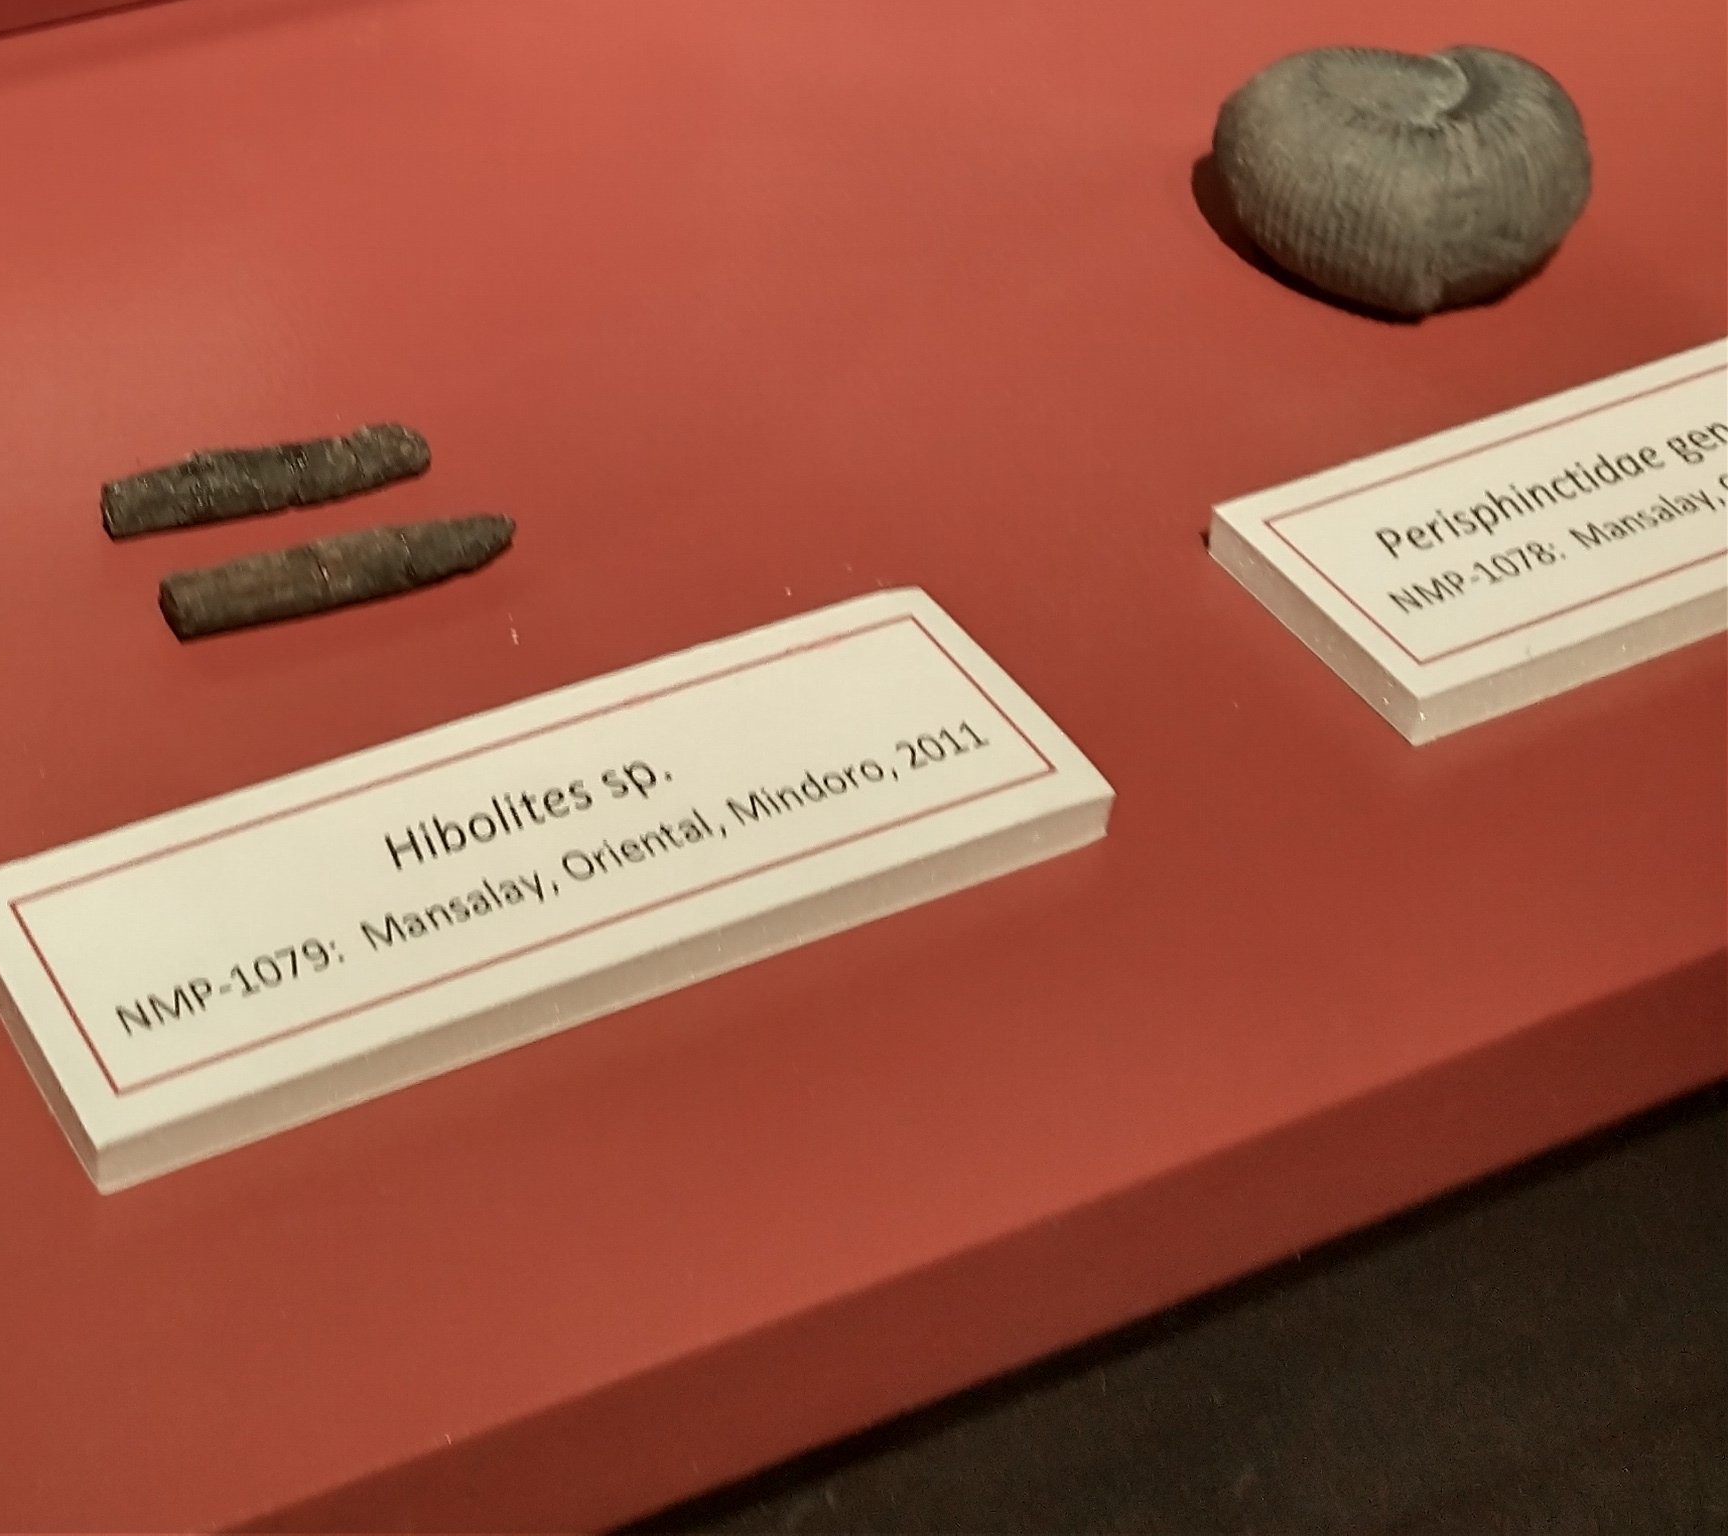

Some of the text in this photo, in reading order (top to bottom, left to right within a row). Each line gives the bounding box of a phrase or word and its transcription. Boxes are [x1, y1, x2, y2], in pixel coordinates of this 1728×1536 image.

[1375, 447, 1665, 559] Perisphinctidae
[1386, 488, 1727, 616] NMP-1078: Mansalay,
[383, 759, 674, 874] Hibolites sp.
[113, 718, 991, 1038] NMP-1079: Mansalay, Oriental, Mindoro, 2011
